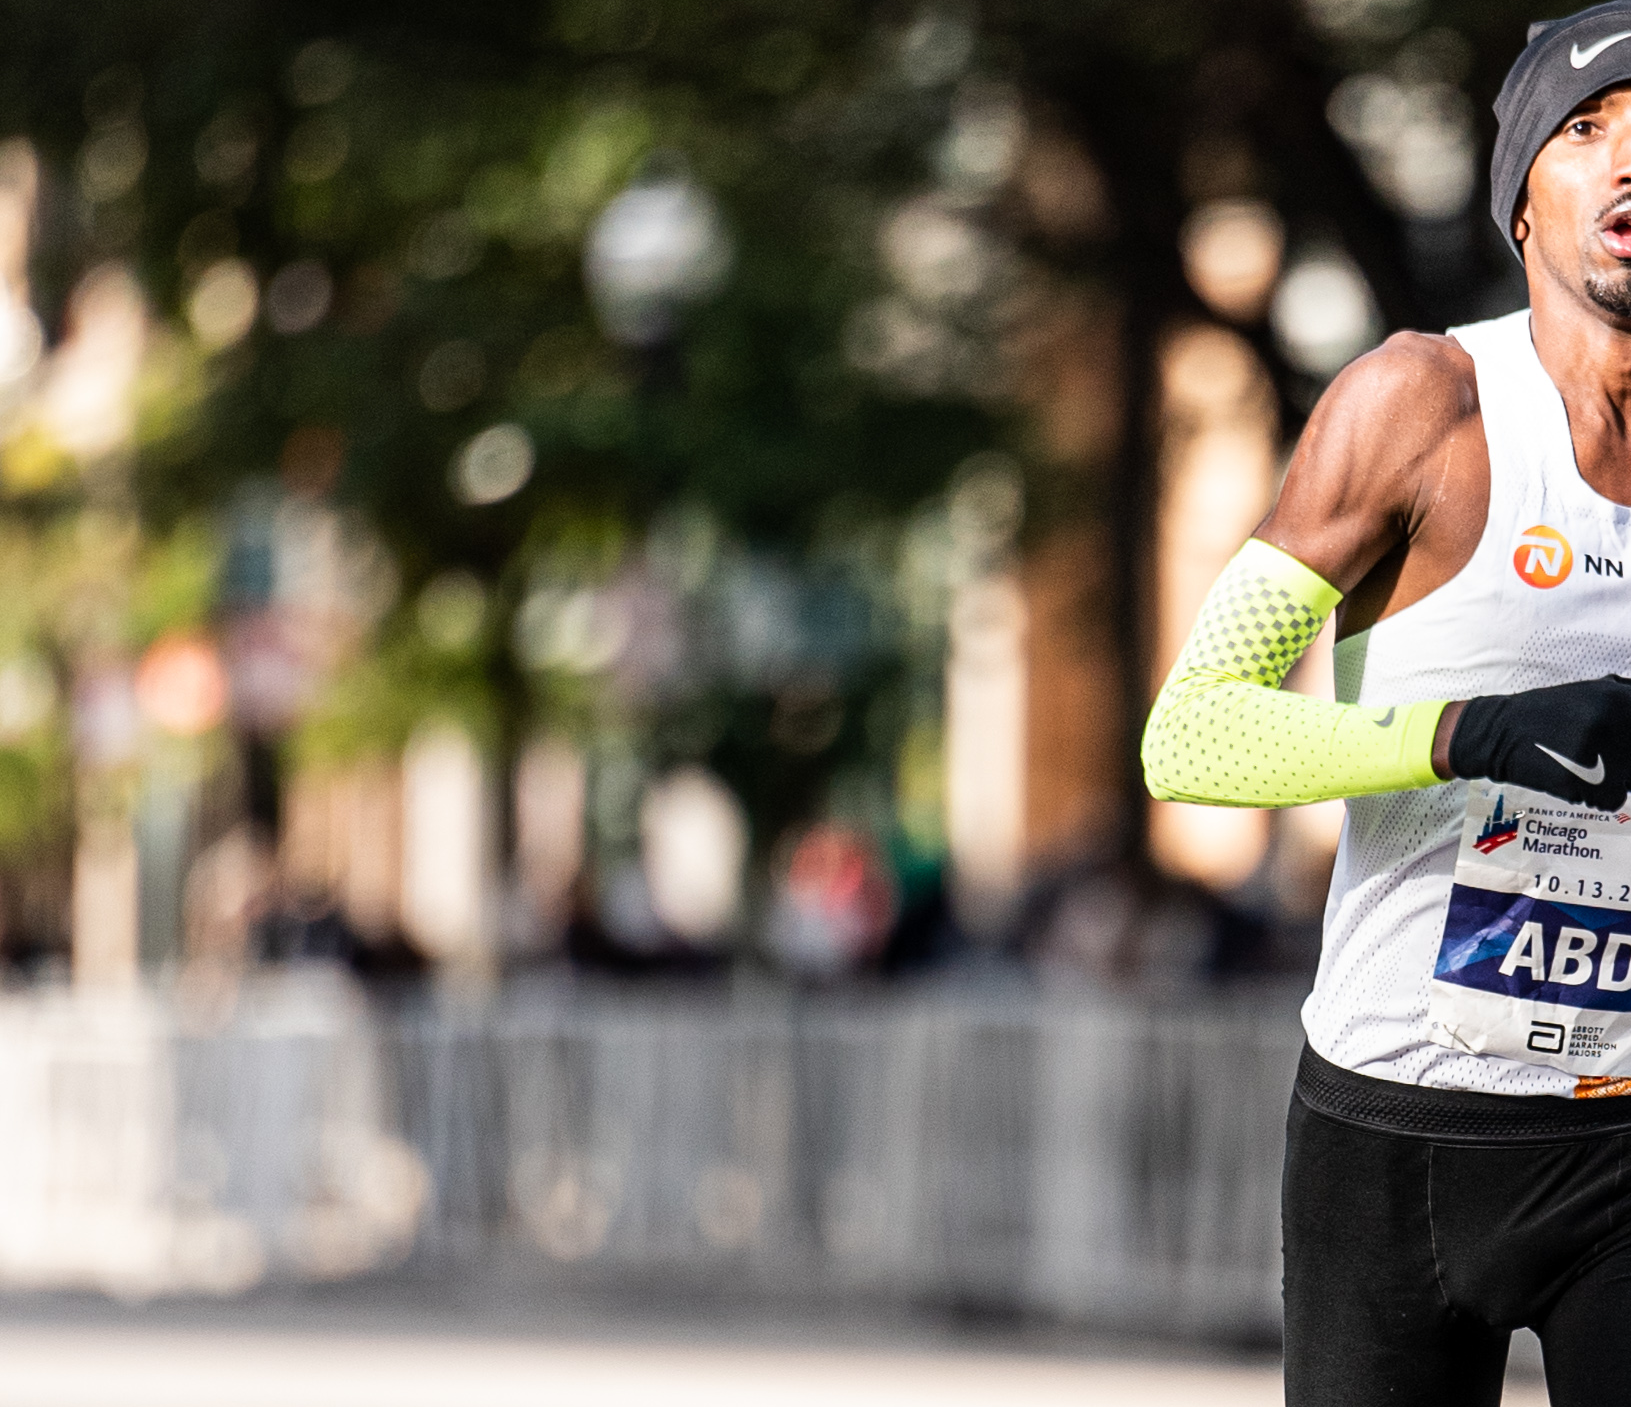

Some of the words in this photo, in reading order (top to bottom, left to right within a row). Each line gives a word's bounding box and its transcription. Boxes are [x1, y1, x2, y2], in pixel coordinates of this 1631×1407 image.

[1583, 553, 1624, 579] NN
[1528, 807, 1554, 817] BANK
[1556, 810, 1567, 818] OF
[1569, 812, 1610, 822] AMERICA
[1525, 819, 1588, 843] Chicago
[1572, 1025, 1604, 1034] ABBOTT
[1570, 1033, 1599, 1042] WORLD
[1569, 1041, 1617, 1051] MARATHON
[1567, 1049, 1602, 1058] MAJORS
